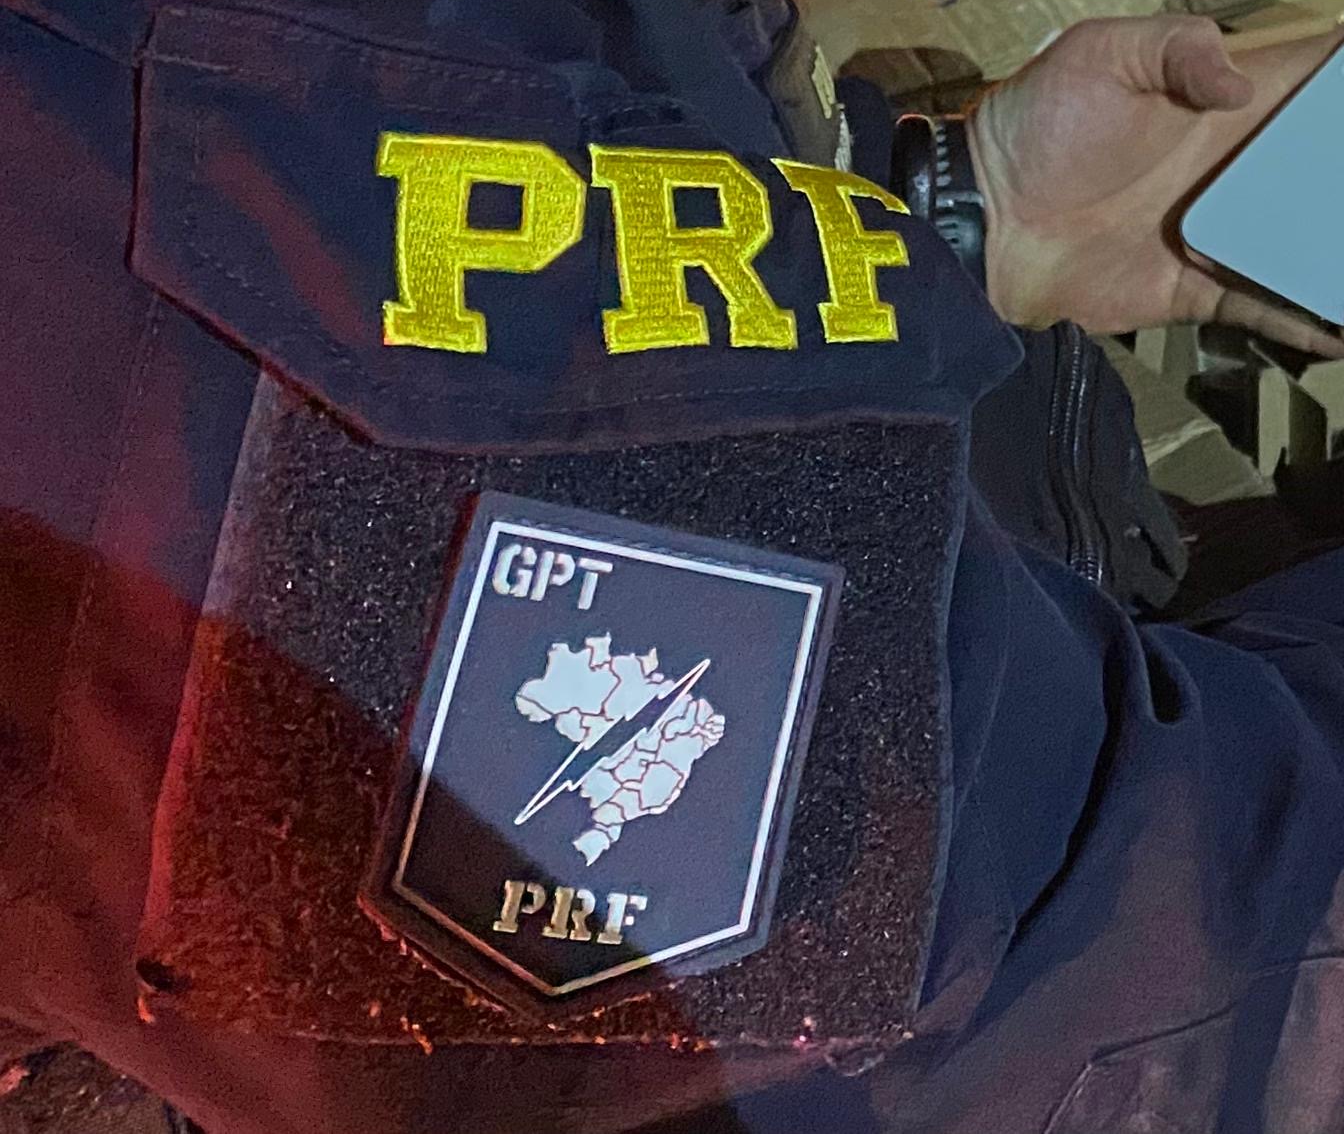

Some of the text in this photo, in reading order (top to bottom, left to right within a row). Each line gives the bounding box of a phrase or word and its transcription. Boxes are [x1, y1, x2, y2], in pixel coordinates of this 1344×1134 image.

[375, 130, 912, 355] PRF
[492, 542, 614, 611] GPT
[492, 879, 649, 946] PRF
